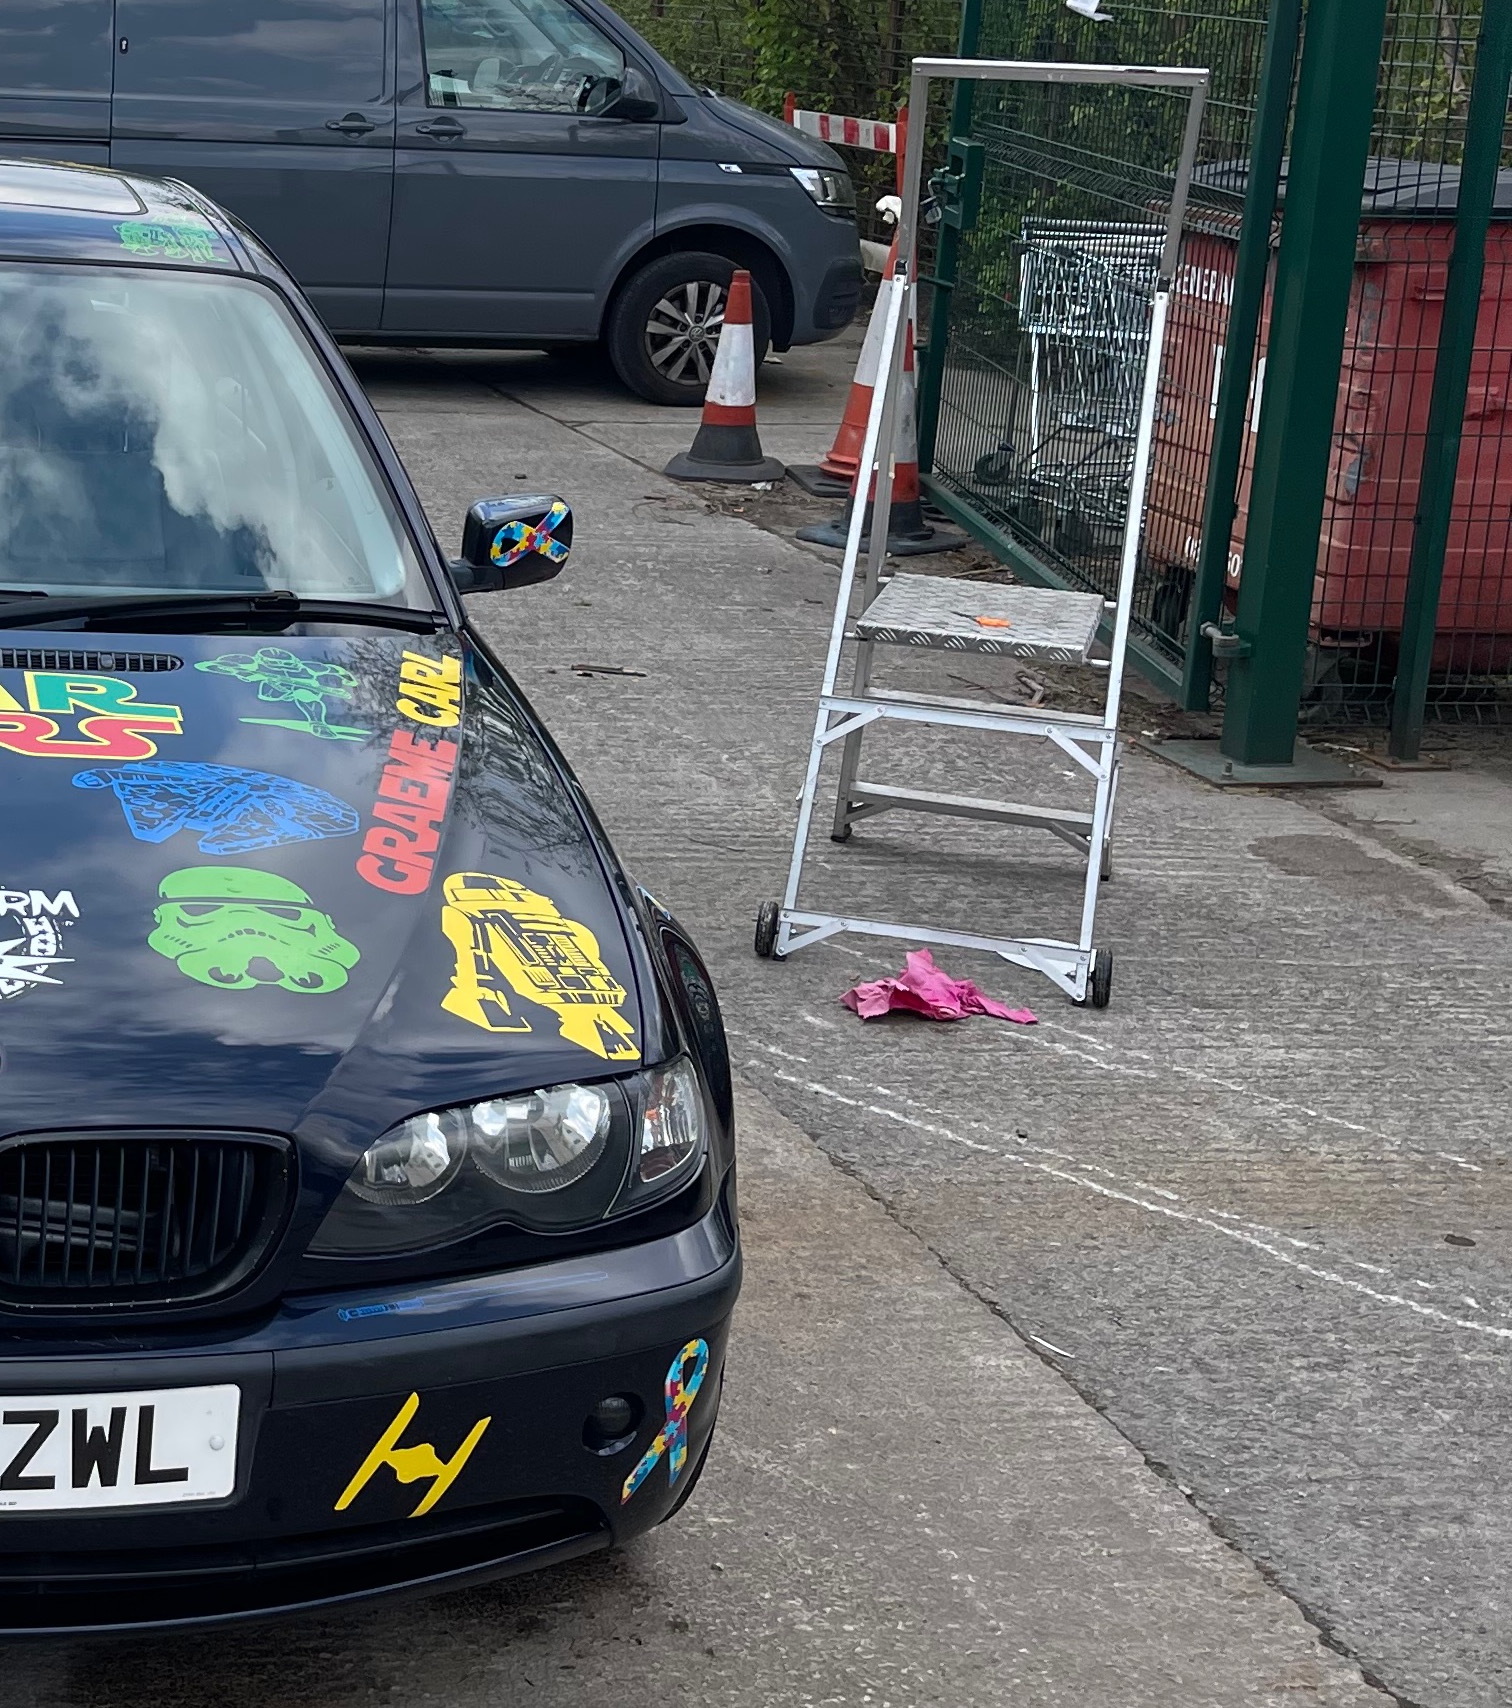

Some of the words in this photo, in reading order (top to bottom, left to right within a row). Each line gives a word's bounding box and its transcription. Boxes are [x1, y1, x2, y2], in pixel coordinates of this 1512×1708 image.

[396, 650, 462, 727] CARL
[355, 729, 458, 895] GRAEME
[0, 1404, 189, 1492] ZWL
